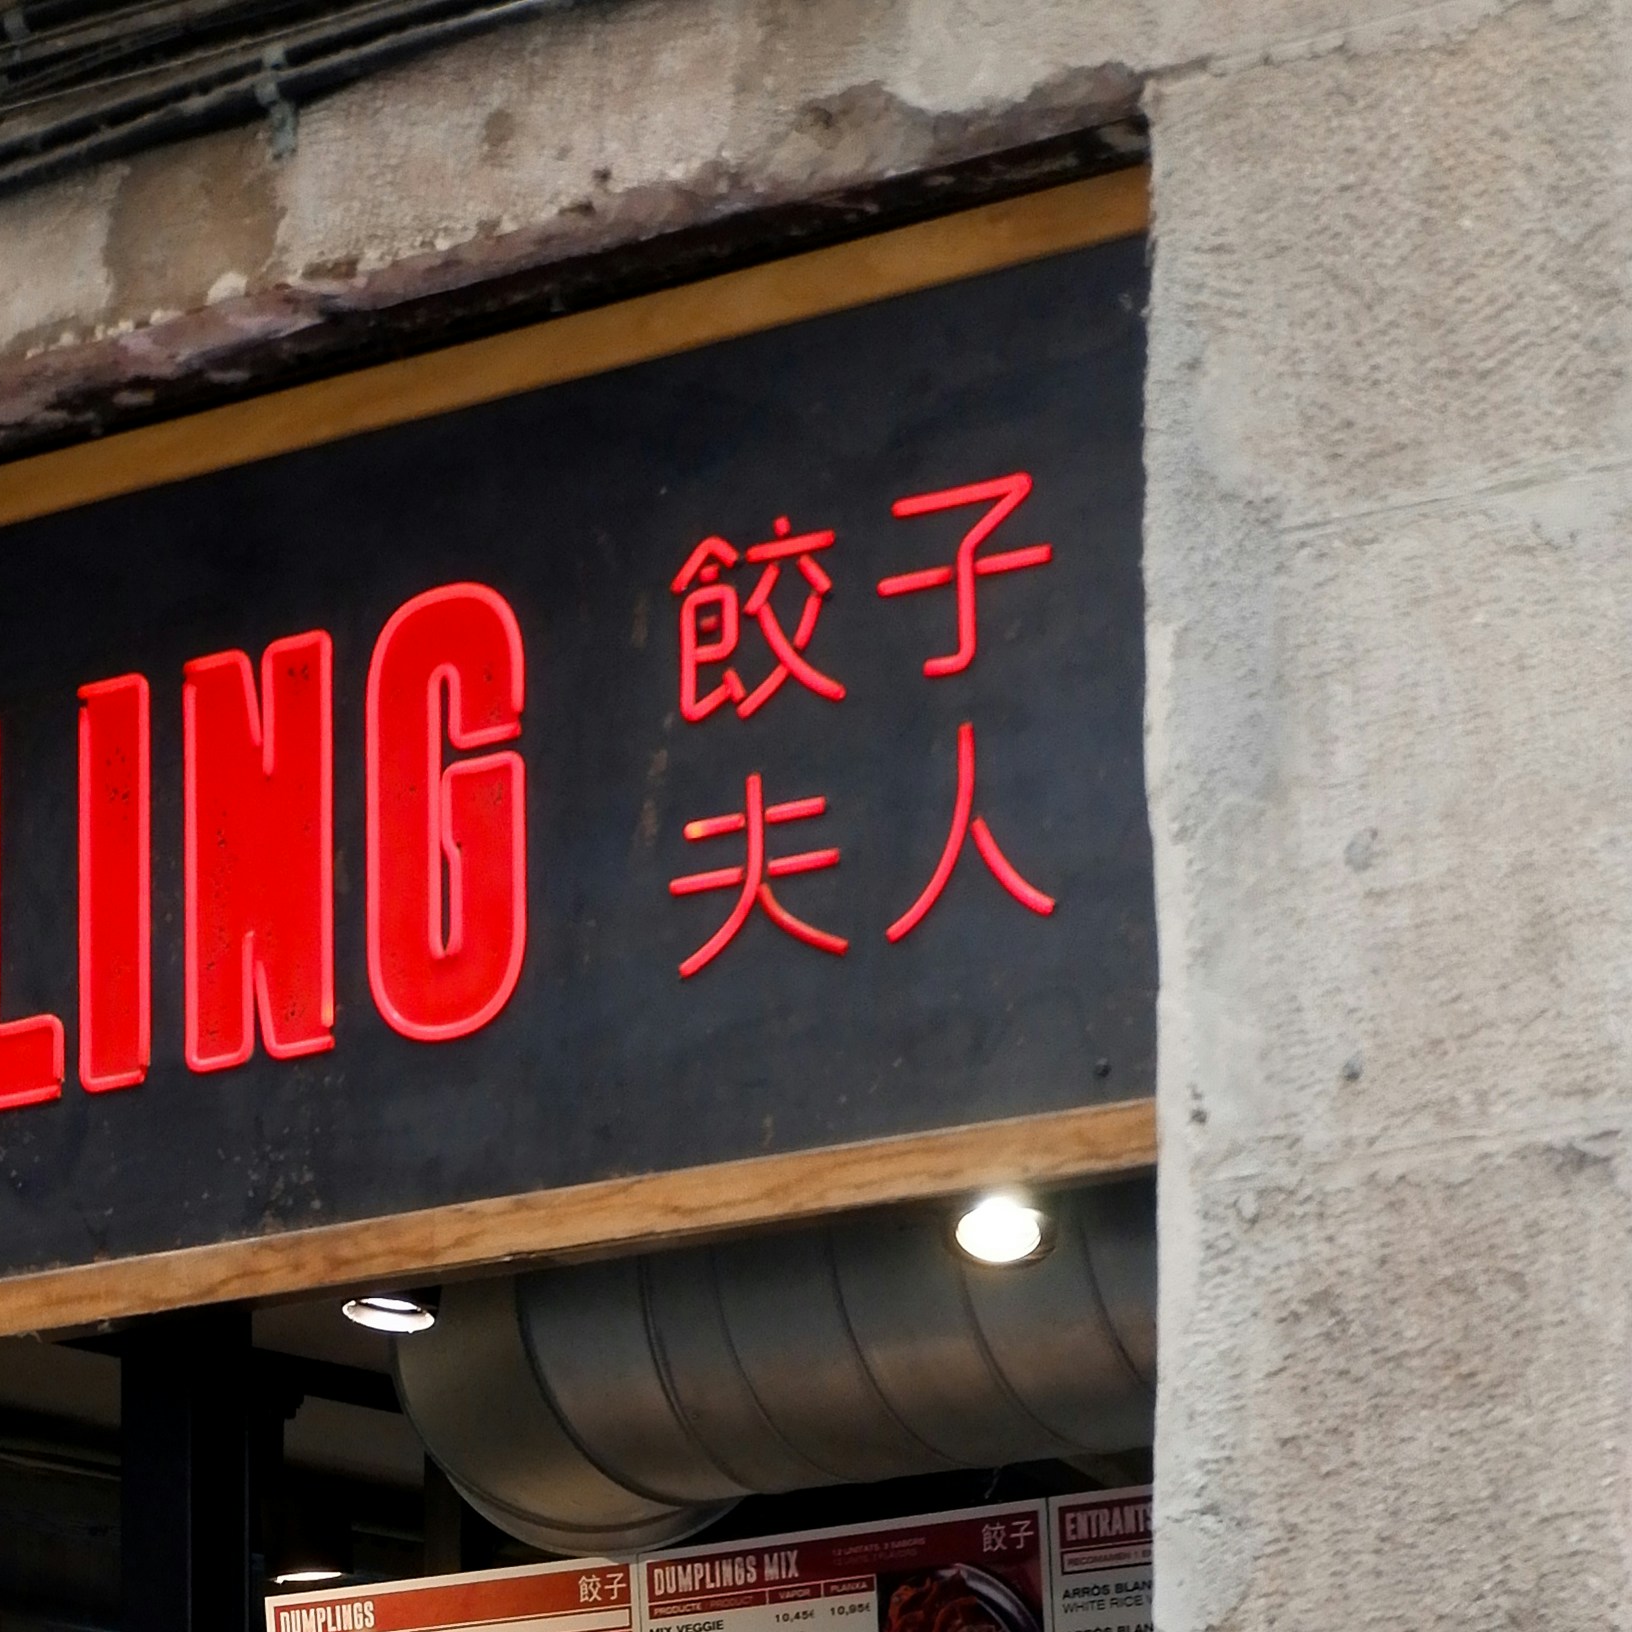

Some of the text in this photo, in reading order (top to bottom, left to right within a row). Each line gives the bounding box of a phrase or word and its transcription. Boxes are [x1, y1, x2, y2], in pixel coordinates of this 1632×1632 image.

[669, 472, 1053, 722] 餃子
[669, 722, 1056, 980] 夫人
[981, 1519, 1034, 1552] 餃子
[578, 1572, 626, 1602] 餃子
[653, 1555, 756, 1595] DUMPLINGS
[763, 1549, 798, 1581] MIX
